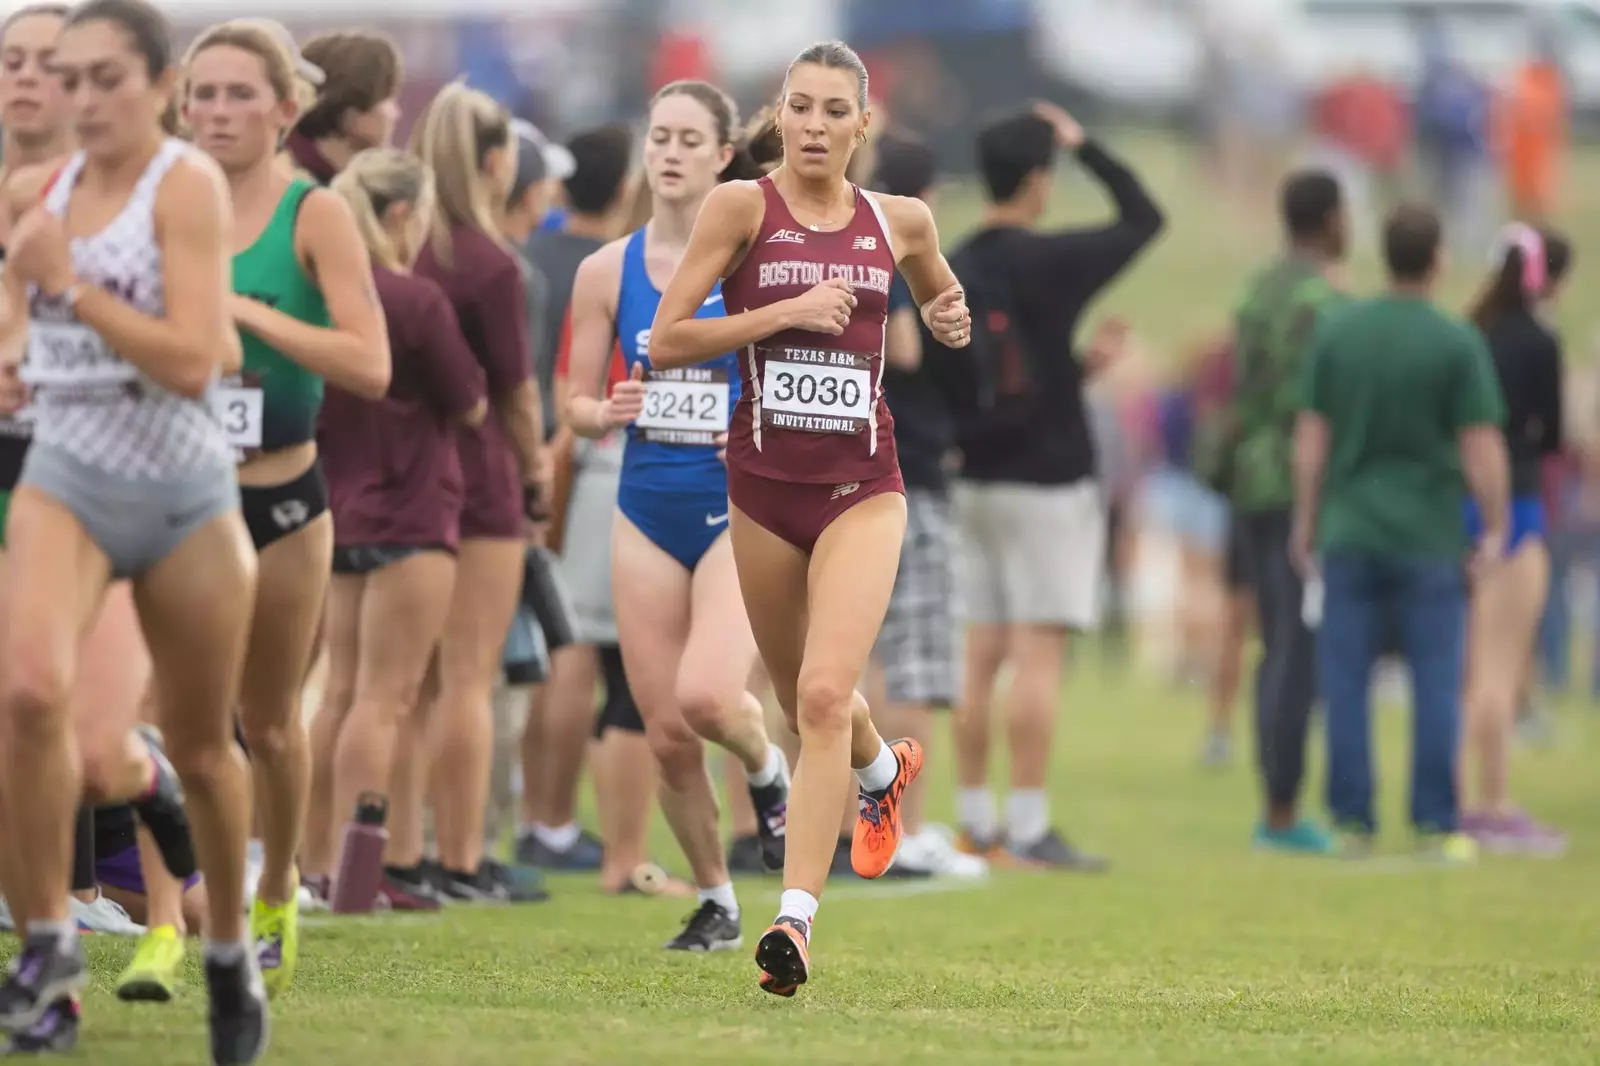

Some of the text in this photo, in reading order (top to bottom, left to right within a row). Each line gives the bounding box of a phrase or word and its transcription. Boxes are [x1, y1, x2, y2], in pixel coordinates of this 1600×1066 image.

[767, 228, 806, 242] ACC
[852, 236, 877, 250] NB
[758, 260, 890, 296] BOSTON COLLEGE
[784, 348, 855, 366] TEXAS A&M
[773, 372, 861, 408] 3030
[646, 391, 718, 421] 3242
[773, 413, 856, 432] INVITATIONAL
